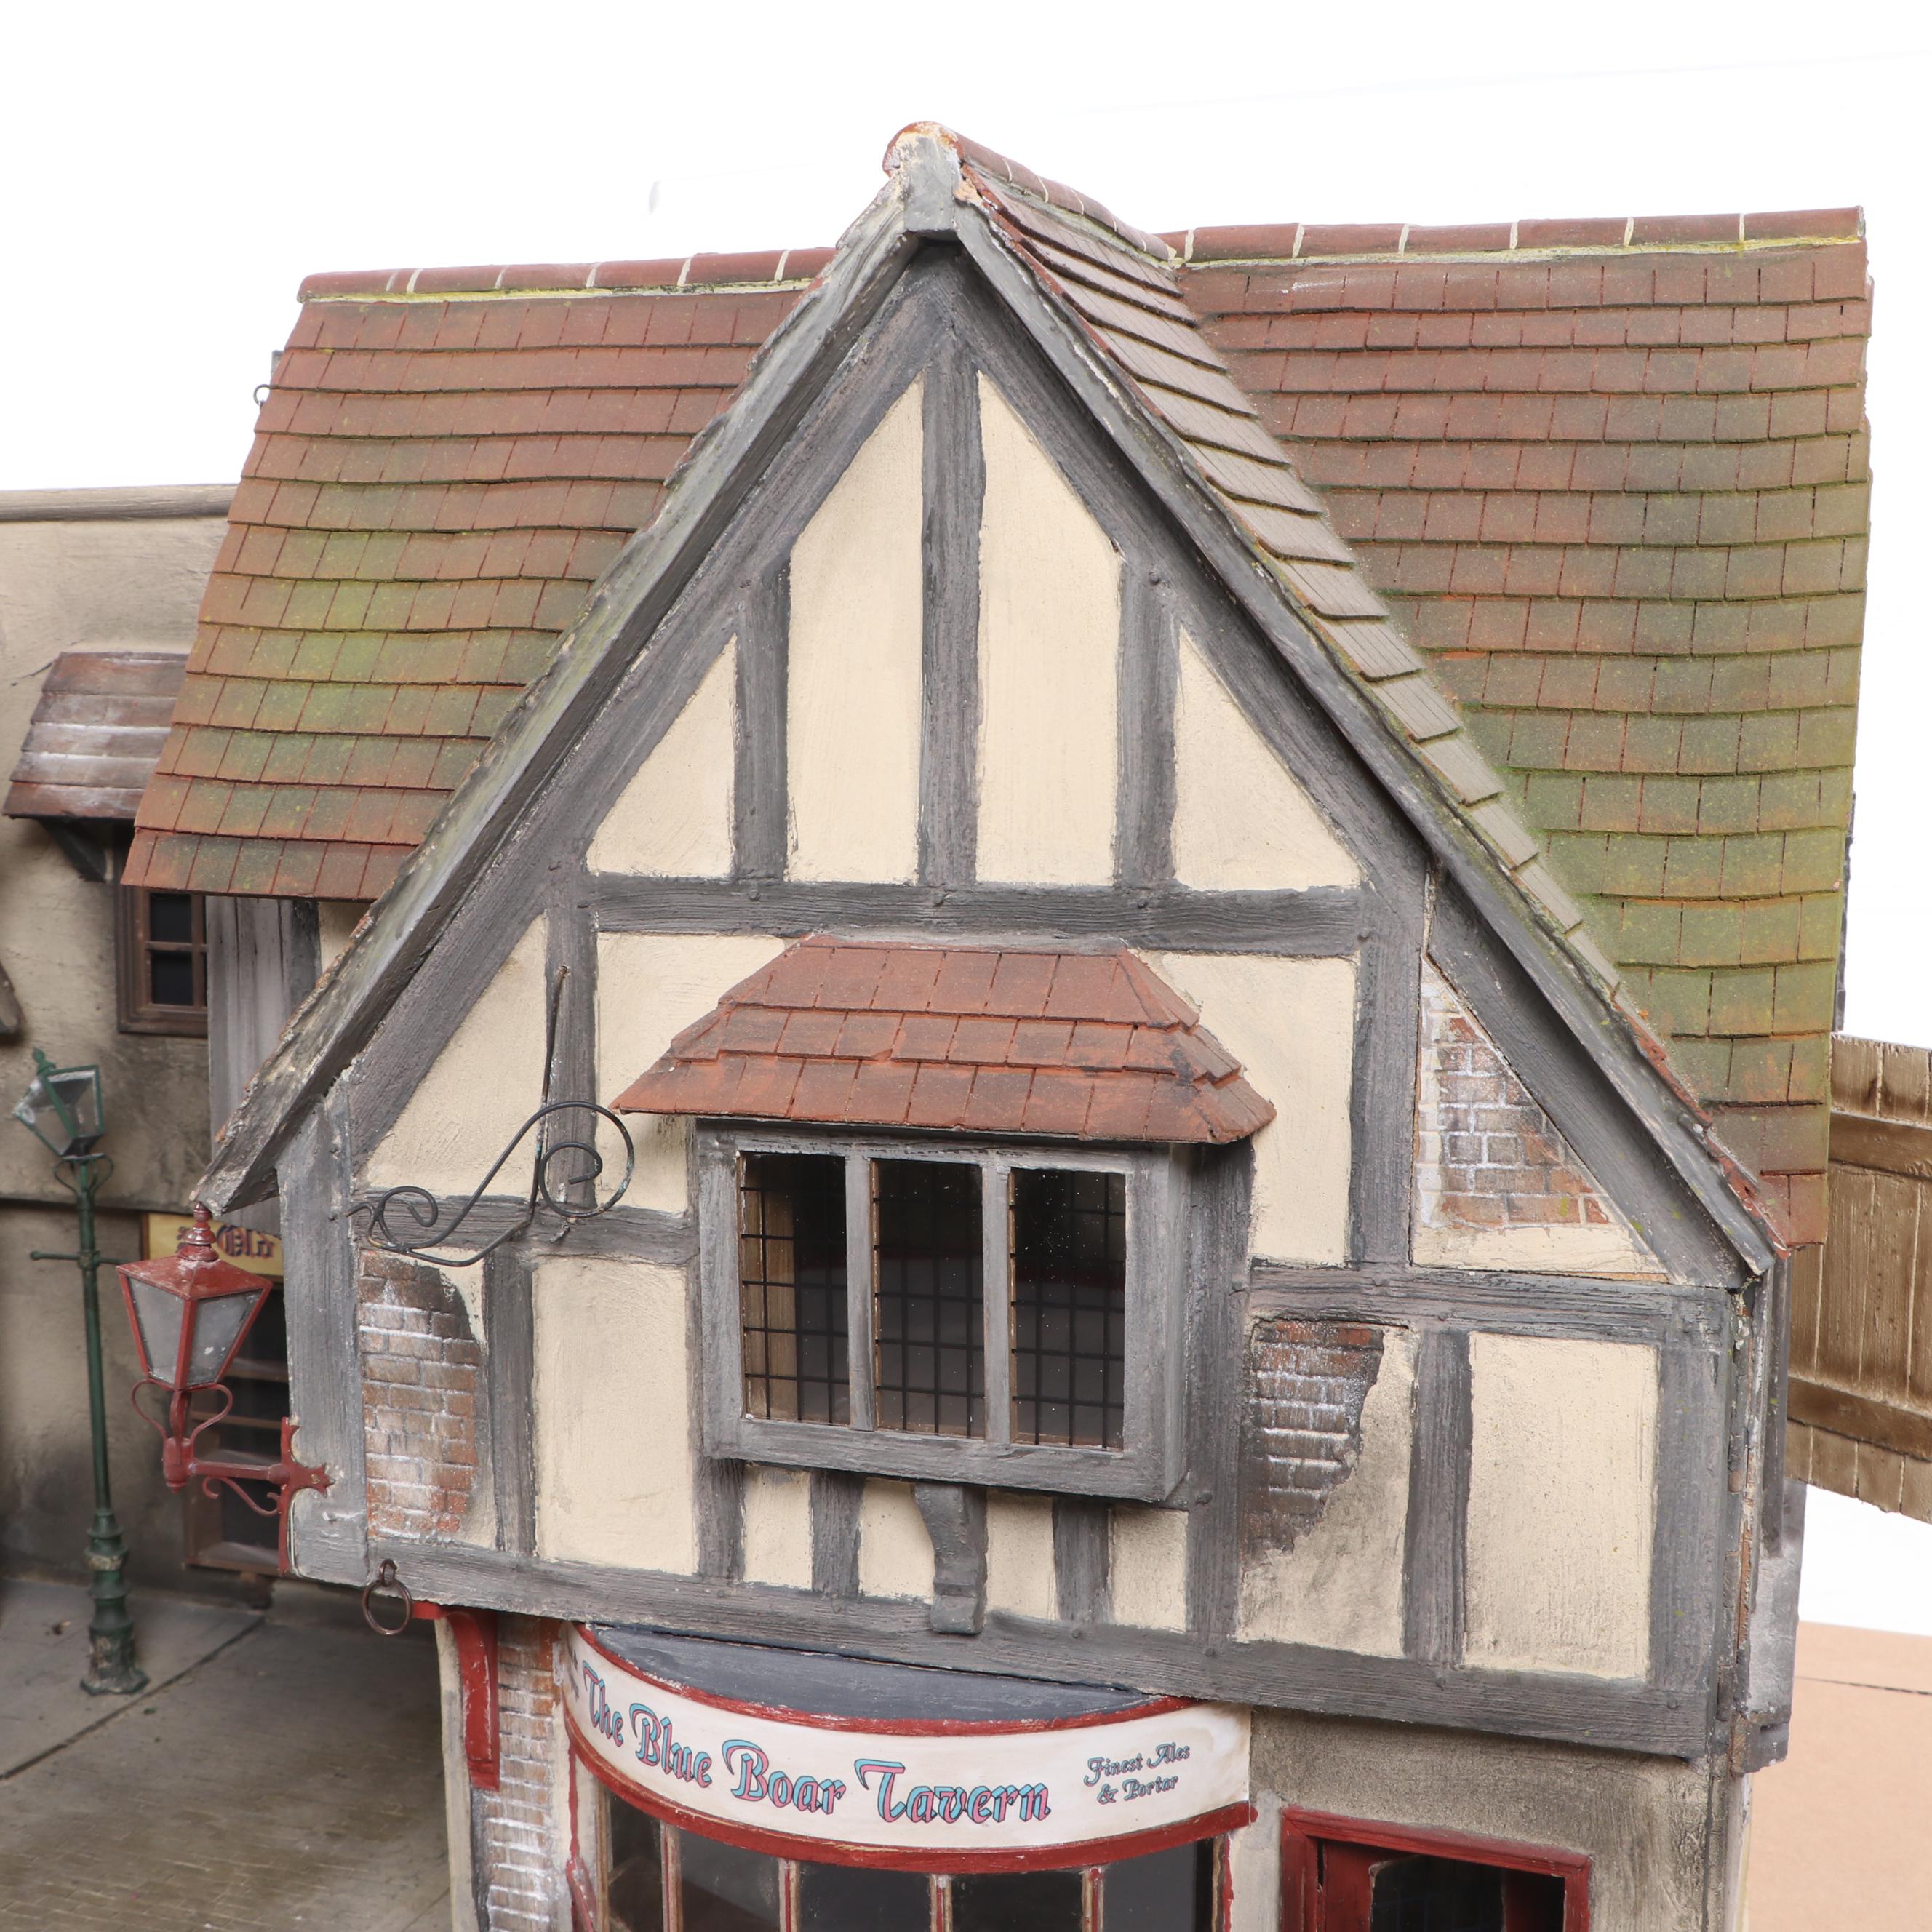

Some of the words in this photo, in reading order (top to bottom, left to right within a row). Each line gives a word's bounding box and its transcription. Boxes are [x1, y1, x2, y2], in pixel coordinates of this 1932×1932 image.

[583, 1660, 623, 1747] The
[629, 1703, 712, 1788] Blue
[722, 1739, 846, 1814] Boar
[854, 1759, 1051, 1824] Tavern
[1083, 1753, 1143, 1787] Finest
[1146, 1741, 1190, 1769] Ales
[1097, 1783, 1119, 1805] &
